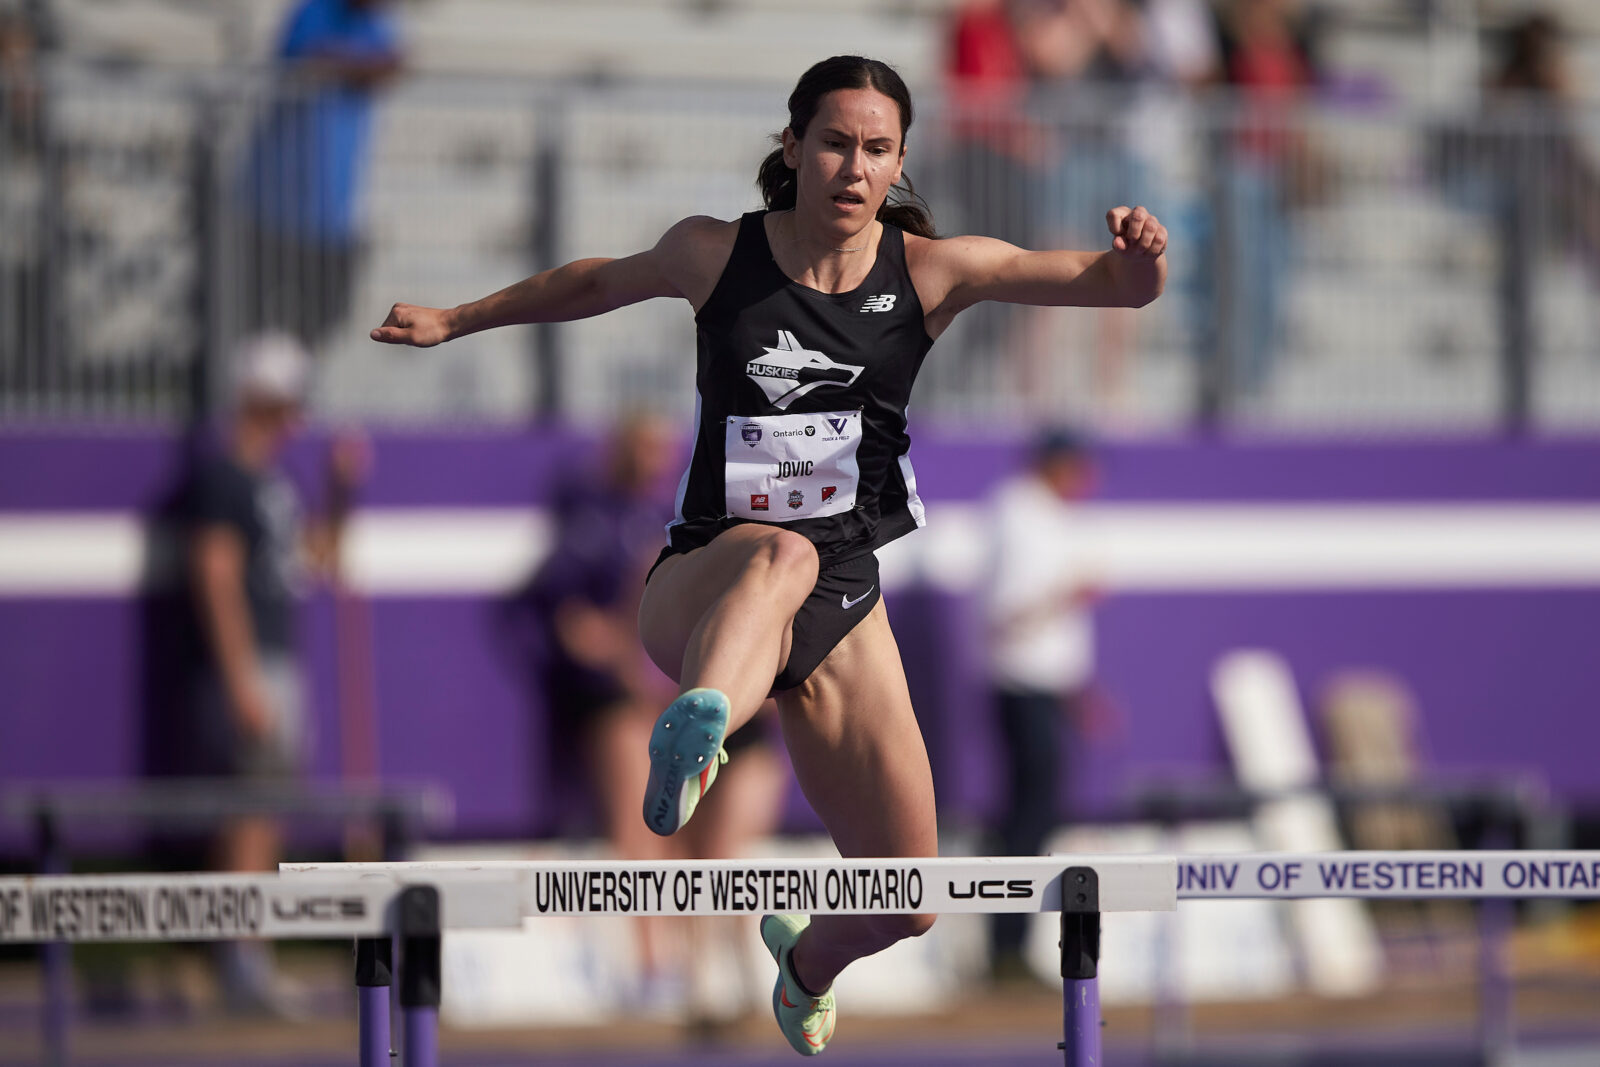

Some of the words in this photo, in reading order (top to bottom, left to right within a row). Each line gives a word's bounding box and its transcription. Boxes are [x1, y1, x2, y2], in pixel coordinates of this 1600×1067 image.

[746, 363, 799, 379] HUSKIES
[773, 428, 803, 438] Ontario
[776, 460, 814, 479] JOVIC
[1257, 862, 1302, 891] OF
[1318, 860, 1483, 890] WESTERN
[536, 870, 666, 913] UNIVERSITY
[673, 869, 703, 912] OF
[710, 868, 817, 912] WESTERN
[825, 867, 923, 911] ONTARIO
[948, 879, 1034, 899] UCS
[30, 885, 148, 936] WESTERN
[153, 883, 264, 932] ONTARIO
[271, 896, 367, 921] UCS
